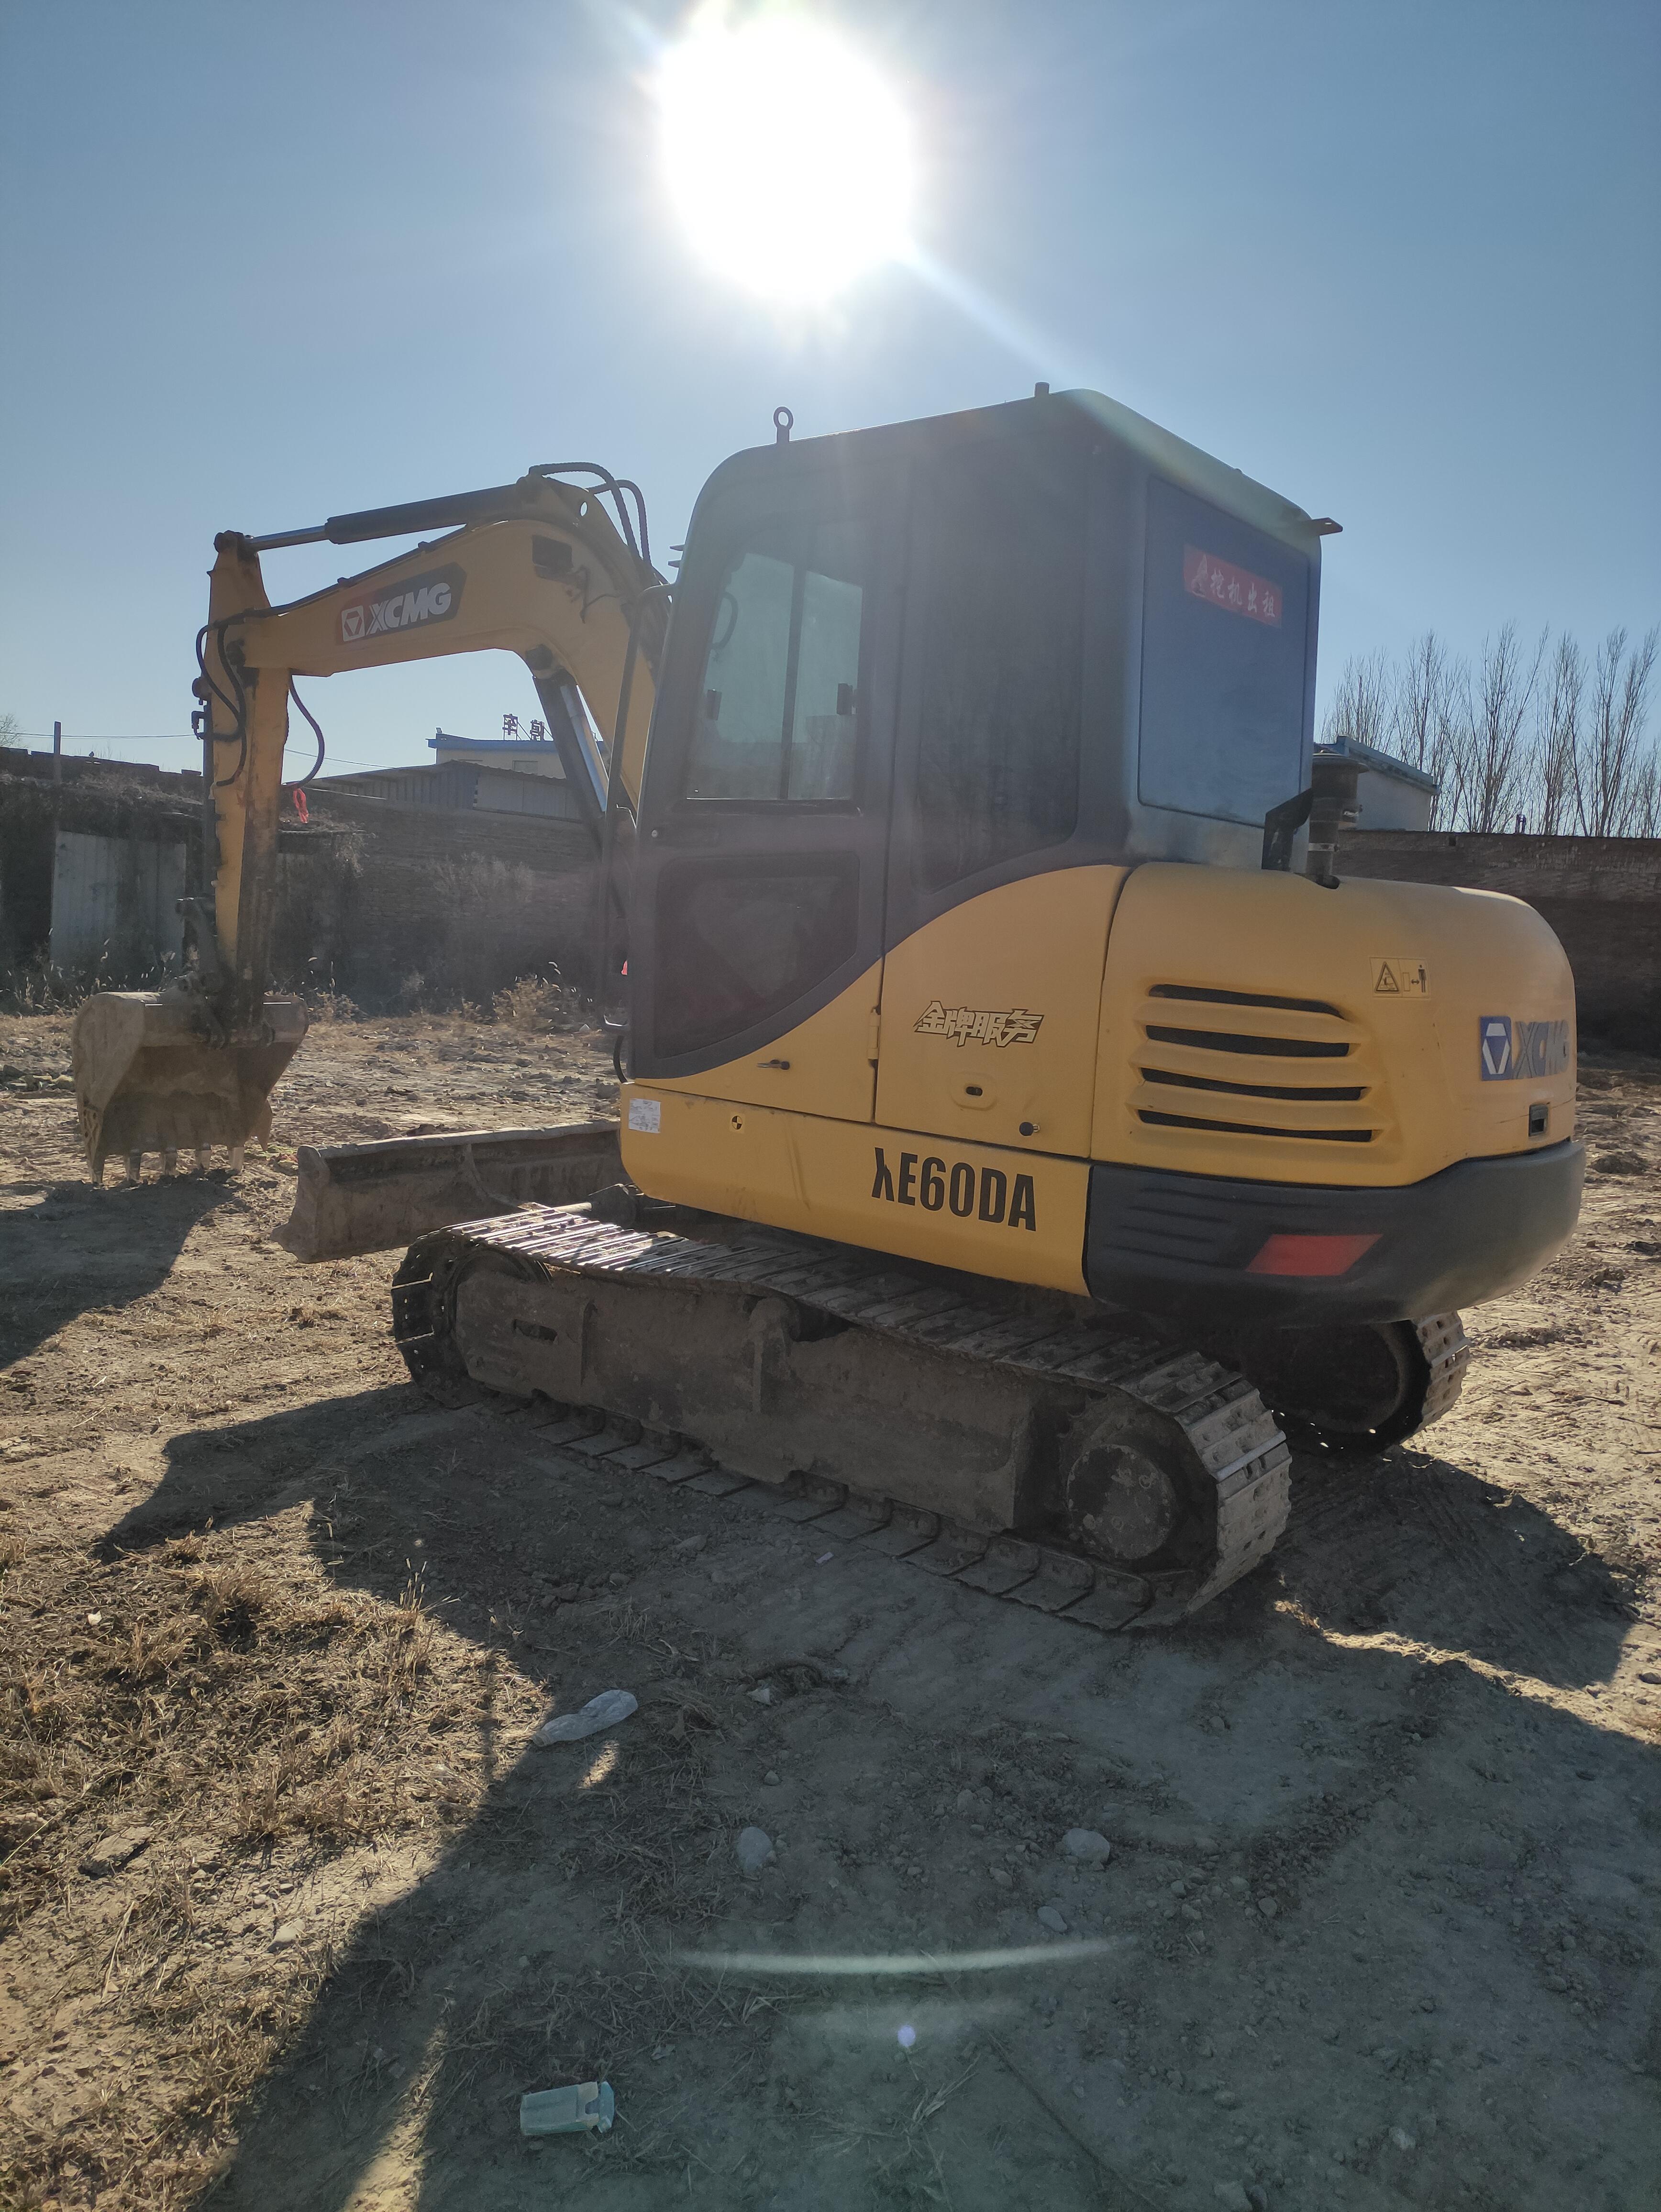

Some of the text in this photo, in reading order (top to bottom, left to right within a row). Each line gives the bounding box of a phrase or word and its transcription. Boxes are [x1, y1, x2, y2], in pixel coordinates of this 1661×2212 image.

[365, 582, 452, 635] XCMG
[912, 1000, 1044, 1048] 金牌服务
[871, 1147, 1036, 1231] XE60DA
